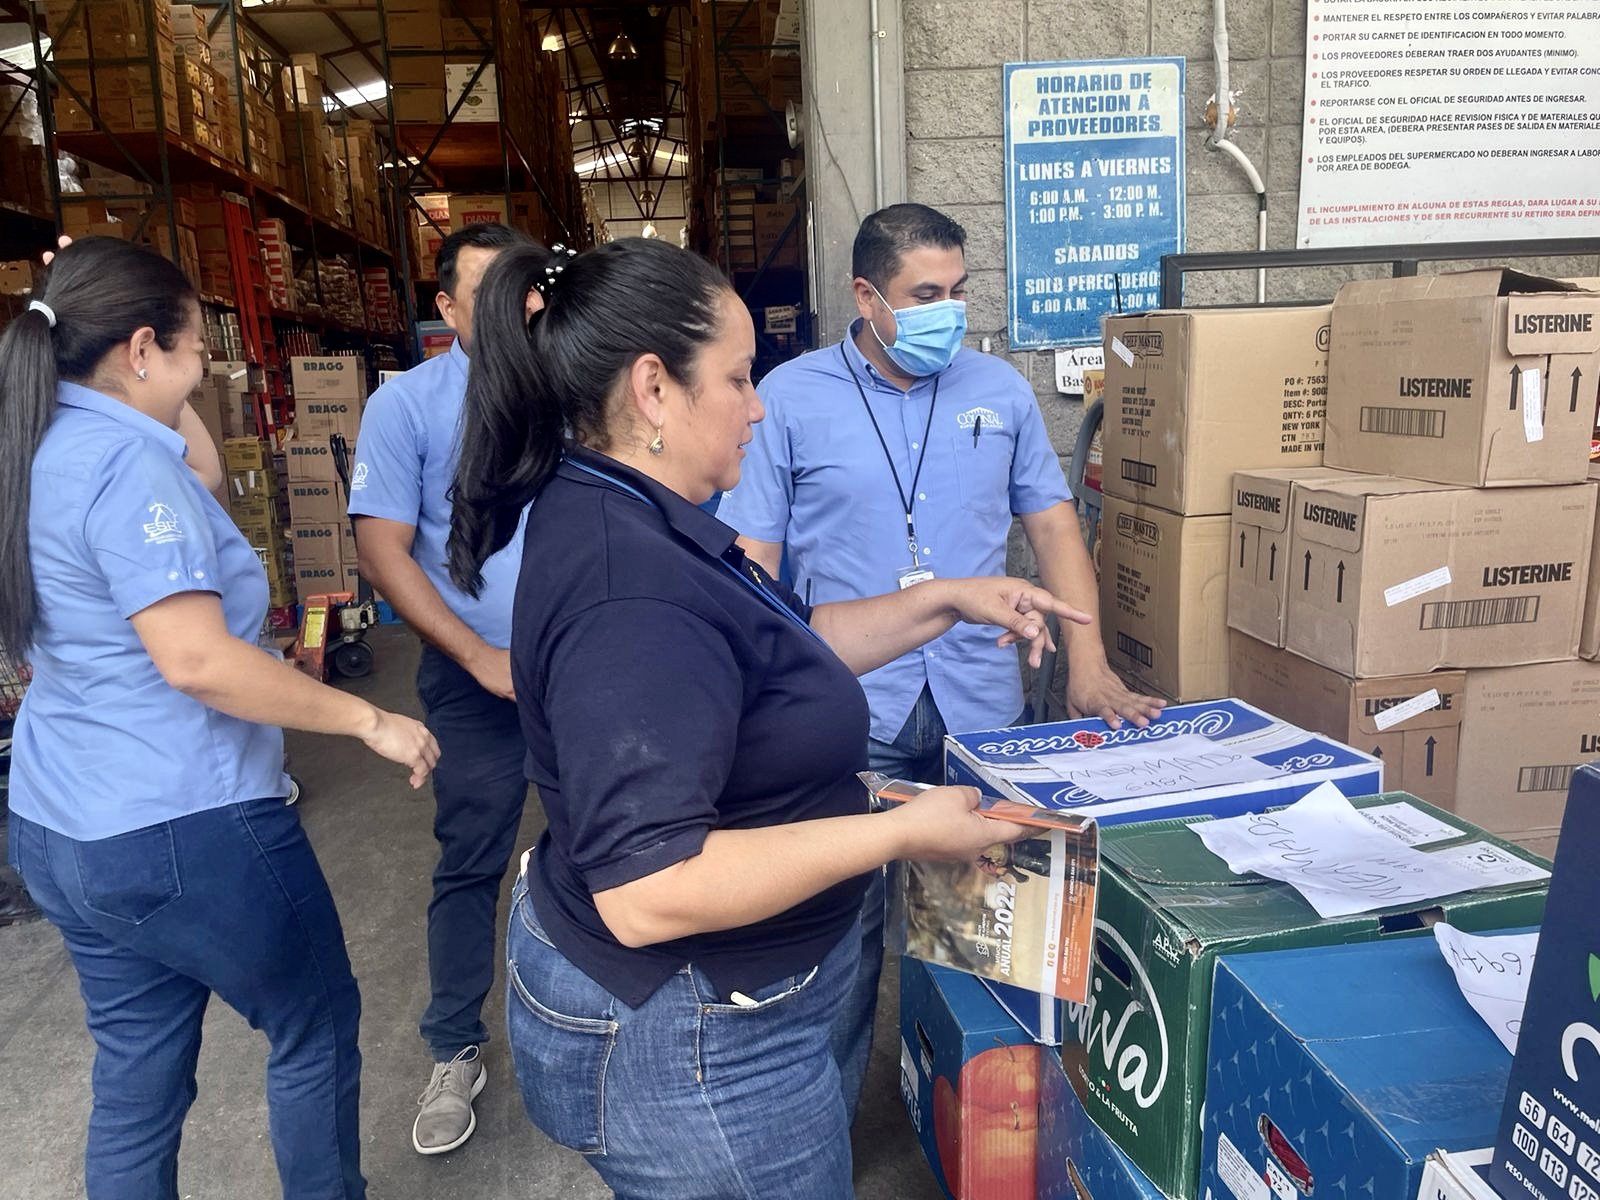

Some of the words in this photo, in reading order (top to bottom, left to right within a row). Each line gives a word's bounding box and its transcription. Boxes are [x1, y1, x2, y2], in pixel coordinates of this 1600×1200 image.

[1323, 14, 1369, 22] MANTENER
[1384, 13, 1422, 21] RESPETO
[1472, 11, 1528, 20] COMPAÑEROS
[1537, 12, 1565, 20] EVITAR
[1323, 33, 1356, 41] PORTAR
[1372, 32, 1405, 40] CARNET
[1421, 31, 1485, 39] IDENTIFICACION
[1322, 52, 1338, 60] LOS
[1341, 51, 1403, 60] PROVEEDORES
[1405, 50, 1445, 58] DEBERAN
[1495, 49, 1542, 57] AYUDANTES
[1544, 49, 1579, 58] (MINIMO).
[1321, 71, 1338, 79] LOS
[1340, 70, 1402, 78] PROVEEDORES
[1405, 69, 1447, 77] RESPETAR
[1450, 68, 1460, 76] SU
[1036, 73, 1122, 94] HORARIO
[1130, 72, 1152, 90] DE
[1334, 80, 1371, 88] TRAFICO.
[1038, 94, 1131, 116] ATENCION
[1138, 94, 1150, 112] A
[1320, 99, 1375, 107] REPORTARSE
[1410, 96, 1442, 104] OFICIAL
[1457, 95, 1504, 103] SEGURIDAD
[1028, 114, 1161, 137] PROVEEDORES
[1319, 118, 1329, 126] EL
[1331, 117, 1363, 125] OFICIAL
[1380, 115, 1427, 124] SEGURIDAD
[1430, 114, 1453, 122] HACE
[1494, 113, 1519, 121] FISICA
[1319, 127, 1336, 135] POR
[1338, 126, 1359, 134] ESTA
[1361, 126, 1386, 134] AREA,
[1388, 124, 1424, 134] (DEBERA
[1426, 123, 1475, 132] PRESENTAR
[1517, 122, 1544, 130] SALIDA
[1546, 122, 1557, 130] EN
[1318, 136, 1324, 144] Y
[1326, 135, 1367, 145] EQUIPOS).
[1317, 155, 1334, 163] LOS
[1336, 153, 1387, 162] EMPLEADOS
[1389, 152, 1405, 161] DEL
[1407, 151, 1475, 160] SUPERMERCADO
[1477, 150, 1489, 158] NO
[1491, 150, 1528, 158] DEBERAN
[1530, 149, 1569, 157] INGRESAR
[1570, 149, 1576, 157] A
[1020, 161, 1074, 181] LUNES
[1081, 160, 1092, 178] A
[1100, 157, 1171, 177] VIERNES
[1317, 164, 1334, 172] POR
[1335, 163, 1359, 171] AREA
[1374, 162, 1411, 170] BODEGA.
[1030, 190, 1058, 205] 6:00
[1062, 188, 1089, 204] A.M.
[1109, 185, 1143, 201] 12:00
[1147, 184, 1162, 199] M.
[1029, 208, 1055, 224] 1:00
[1103, 204, 1132, 219] 3:00
[1149, 203, 1163, 218] M.
[1054, 243, 1140, 265] SABADOS
[1025, 276, 1063, 296] SOLO
[1068, 271, 1161, 292] PERECDERO
[1032, 298, 1060, 314] 6:00
[1064, 296, 1090, 312] A.M.
[1514, 314, 1592, 334] LISTERINE
[303, 361, 344, 372] BRAGG
[1285, 377, 1294, 386] PO
[1400, 376, 1472, 398] LISTERINE
[1284, 389, 1300, 397] Item
[308, 404, 348, 414] BRAGG
[1283, 400, 1304, 408] DESC:
[1283, 411, 1304, 420] QNTY:
[1282, 422, 1299, 431] NEW
[1301, 422, 1320, 430] YORK
[1282, 434, 1296, 442] CTN
[291, 447, 328, 456] BRAGG
[1281, 444, 1302, 453] MADE
[1304, 443, 1312, 451] IN
[294, 488, 330, 497] BRAGG
[1237, 489, 1281, 514] LISTERINE
[1303, 502, 1357, 532] LISTERINE
[297, 529, 332, 539] BRAGG
[300, 569, 335, 578] BRAGG
[1482, 562, 1573, 587] LISTERINE
[994, 881, 1016, 938] 2022
[1001, 938, 1012, 976] ANUAL
[1102, 1093, 1111, 1108] LA
[1111, 1106, 1138, 1136] FRUTTA
[1524, 1100, 1539, 1122] 56
[1552, 1122, 1569, 1149] 64
[1586, 1149, 1600, 1177] 72
[1517, 1128, 1536, 1157] 100
[1544, 1154, 1564, 1183] 113
[1574, 1181, 1596, 1200] 12
